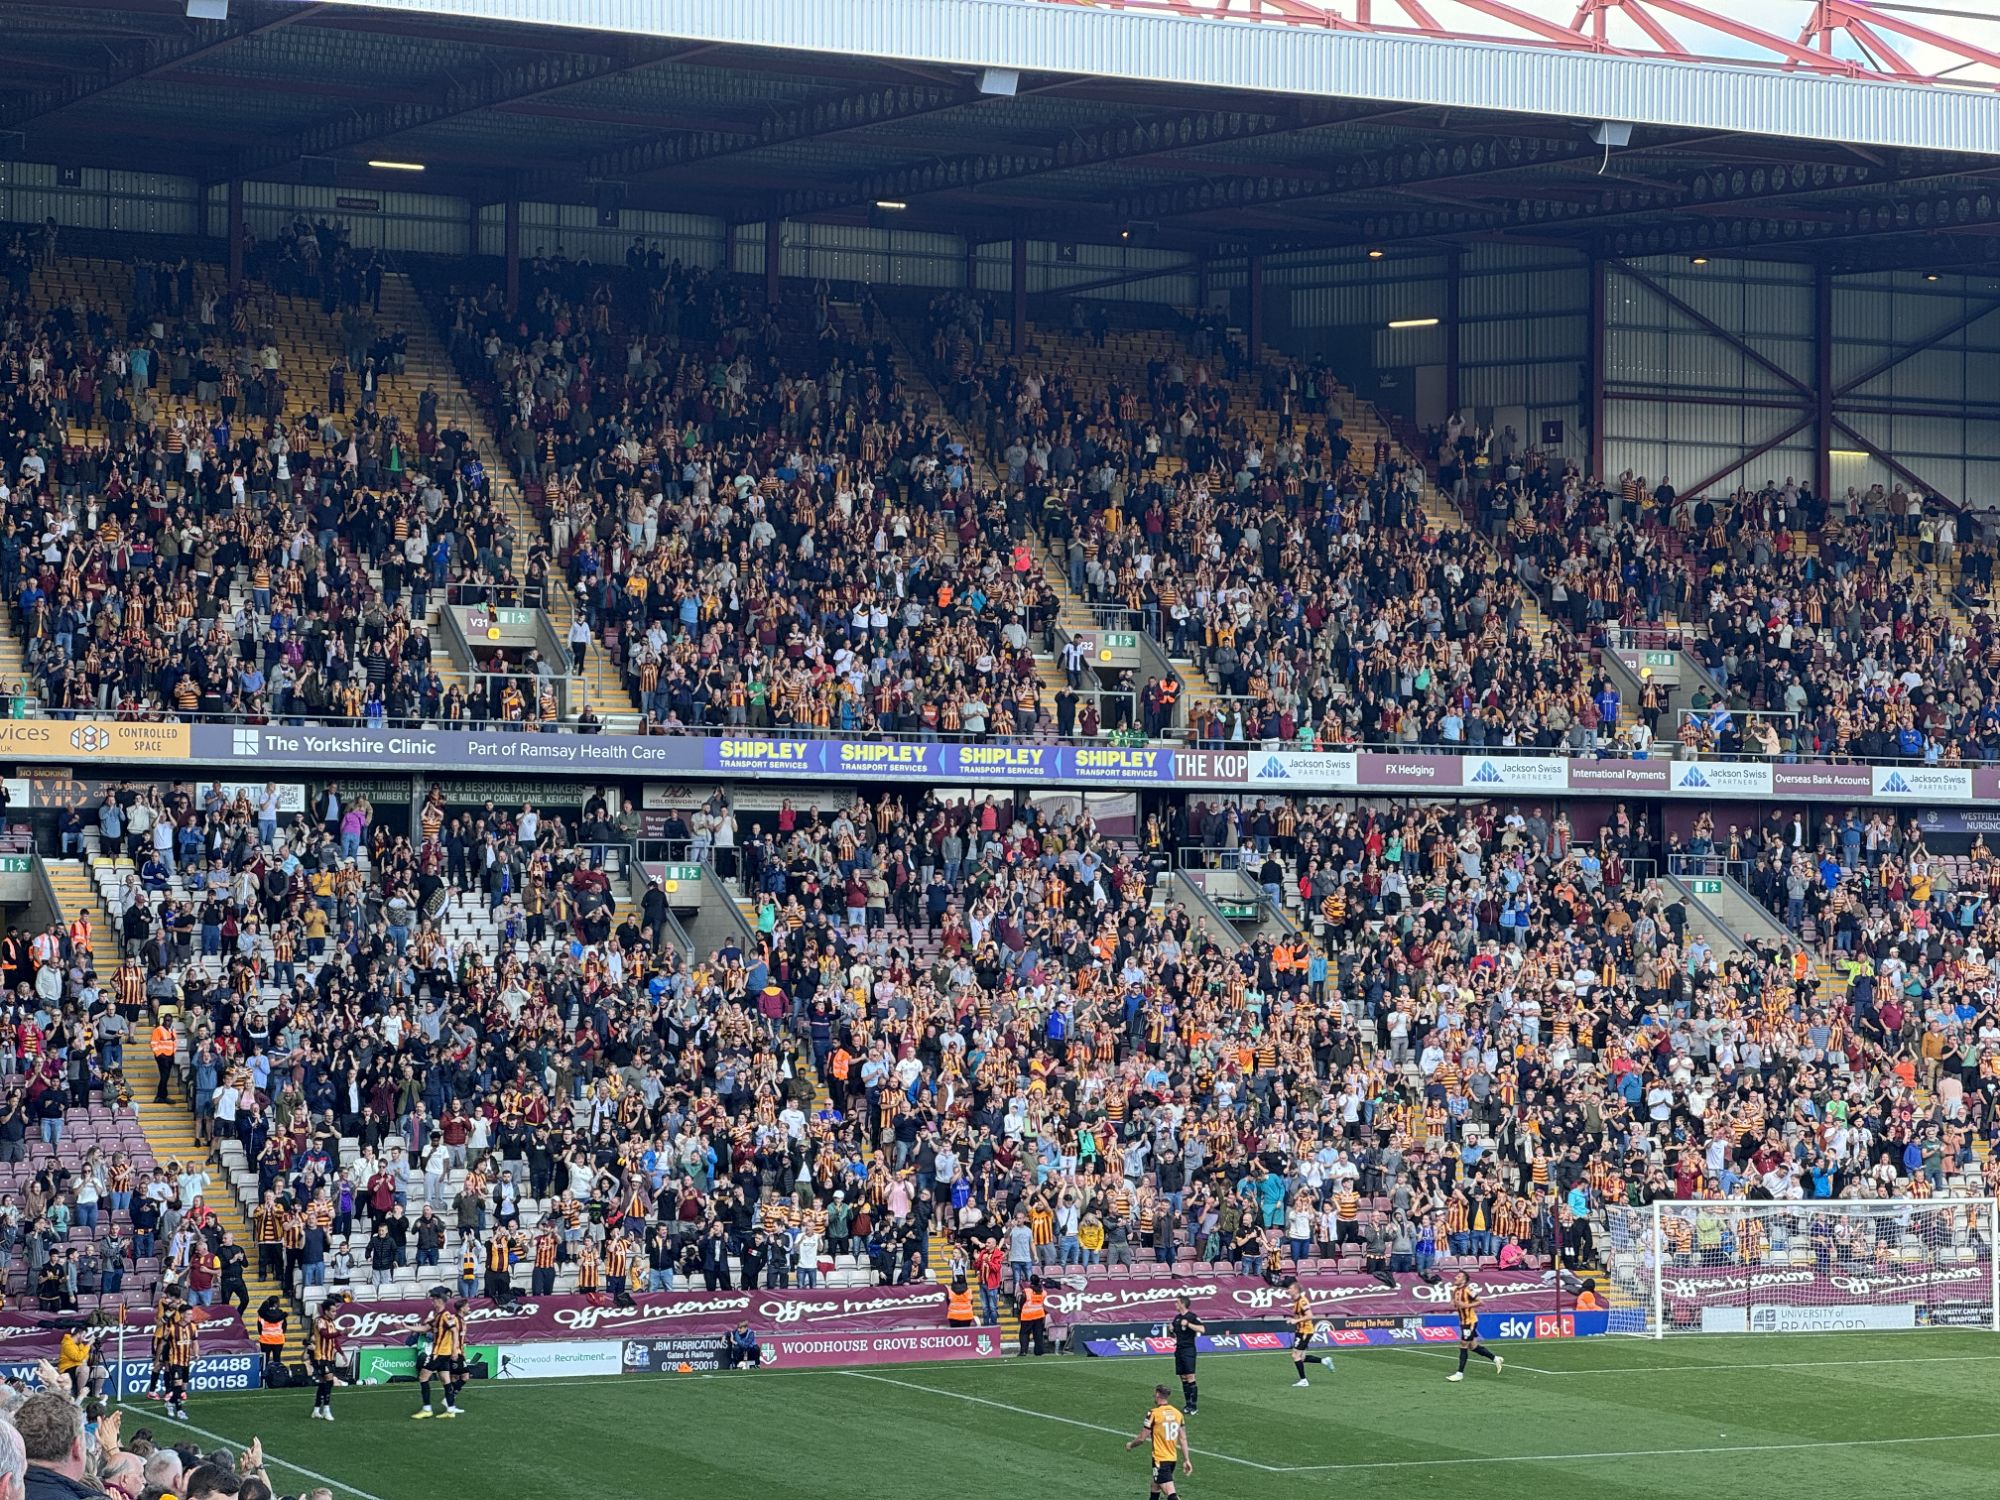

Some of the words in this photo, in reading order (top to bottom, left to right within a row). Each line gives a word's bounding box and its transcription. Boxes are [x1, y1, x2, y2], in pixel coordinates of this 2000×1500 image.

[65, 168, 74, 180] H
[1063, 246, 1071, 256] K
[1550, 427, 1556, 437] L
[470, 618, 488, 628] V31
[1080, 641, 1094, 651] 32
[1624, 660, 1637, 669] 33
[118, 727, 178, 739] CONTROLLED
[134, 741, 162, 751] SPACE
[265, 735, 299, 751] The
[303, 736, 384, 753] Yorkshire
[388, 738, 437, 755] Clinic
[468, 741, 498, 756] Part
[501, 742, 517, 756] of
[520, 742, 578, 761] Ramsay
[580, 744, 628, 759] Health
[630, 746, 666, 760] Care
[719, 740, 807, 759] SHIPLEY
[841, 743, 927, 763] SHIPLEY
[959, 746, 1044, 765] SHIPLEY
[1075, 749, 1157, 768] SHIPLEY
[719, 760, 768, 769] TRANSPORT
[769, 761, 808, 770] SERVICES
[841, 763, 888, 772] TRANSPORT
[889, 764, 927, 772] SERVICES
[1175, 754, 1207, 777] THE
[1213, 755, 1248, 779] KOP
[1288, 757, 1324, 770] Jackson
[1325, 758, 1351, 769] Swiss
[1502, 762, 1536, 774] Jackson
[1537, 763, 1562, 773] Swiss
[33, 770, 70, 778] SMOKING
[959, 765, 1006, 774] TRANSPORT
[1007, 766, 1044, 775] SERVICES
[1075, 768, 1120, 776] TRANSPORT
[1121, 769, 1158, 777] SERVICES
[1297, 769, 1342, 777] PARTNERS
[1385, 764, 1397, 774] FX
[1398, 764, 1435, 777] Hedging
[1572, 767, 1624, 780] International
[1625, 769, 1666, 782] Payments
[1708, 767, 1742, 779] Jackson
[1743, 768, 1767, 779] Swiss
[1511, 773, 1553, 781] PARTNERS
[1775, 774, 1811, 784] Overseas
[1812, 775, 1833, 785] Bank
[1834, 775, 1870, 785] Accounts
[1910, 774, 1942, 784] Jackson
[1943, 775, 1966, 784] Swiss
[348, 780, 374, 791] EDGE
[455, 782, 462, 792] &
[465, 782, 508, 792] BESPOKE
[511, 782, 540, 793] TABLE
[543, 783, 584, 794] MAKERS
[372, 791, 403, 801] TIMBER
[494, 794, 520, 802] CONEY
[546, 795, 583, 804] KEIGHLEY
[648, 874, 663, 884] 26
[1043, 1291, 1117, 1313] Office
[1121, 1283, 1218, 1302] Interiors
[759, 1299, 838, 1322] Office
[843, 1291, 946, 1312] Interiors
[554, 1305, 638, 1330] Office
[643, 1296, 750, 1317] Interiors
[1781, 1309, 1834, 1318] UNIVERSITY
[1835, 1308, 1844, 1318] of
[335, 1311, 421, 1337] Office
[1345, 1319, 1366, 1329] Creating
[1367, 1319, 1376, 1328] The
[1377, 1318, 1395, 1327] Perfect
[1500, 1317, 1532, 1339] sky
[1332, 1329, 1364, 1341] bet
[1388, 1329, 1418, 1340] sky
[1421, 1326, 1451, 1338] bet
[653, 1341, 671, 1351] JBM
[673, 1339, 728, 1350] FABRICATIONS
[782, 1338, 868, 1354] WOODHOUSE
[873, 1337, 917, 1351] GROVE
[920, 1335, 972, 1349] SCHOOL
[1116, 1338, 1148, 1352] sky
[1151, 1337, 1177, 1349] be
[1210, 1334, 1242, 1349] sky
[1244, 1332, 1277, 1345] bet
[667, 1351, 684, 1359] Gates
[691, 1350, 714, 1359] Railings
[370, 1356, 417, 1376] Rotherwoo
[188, 1374, 248, 1391] 190158
[1162, 1421, 1180, 1441] 18
